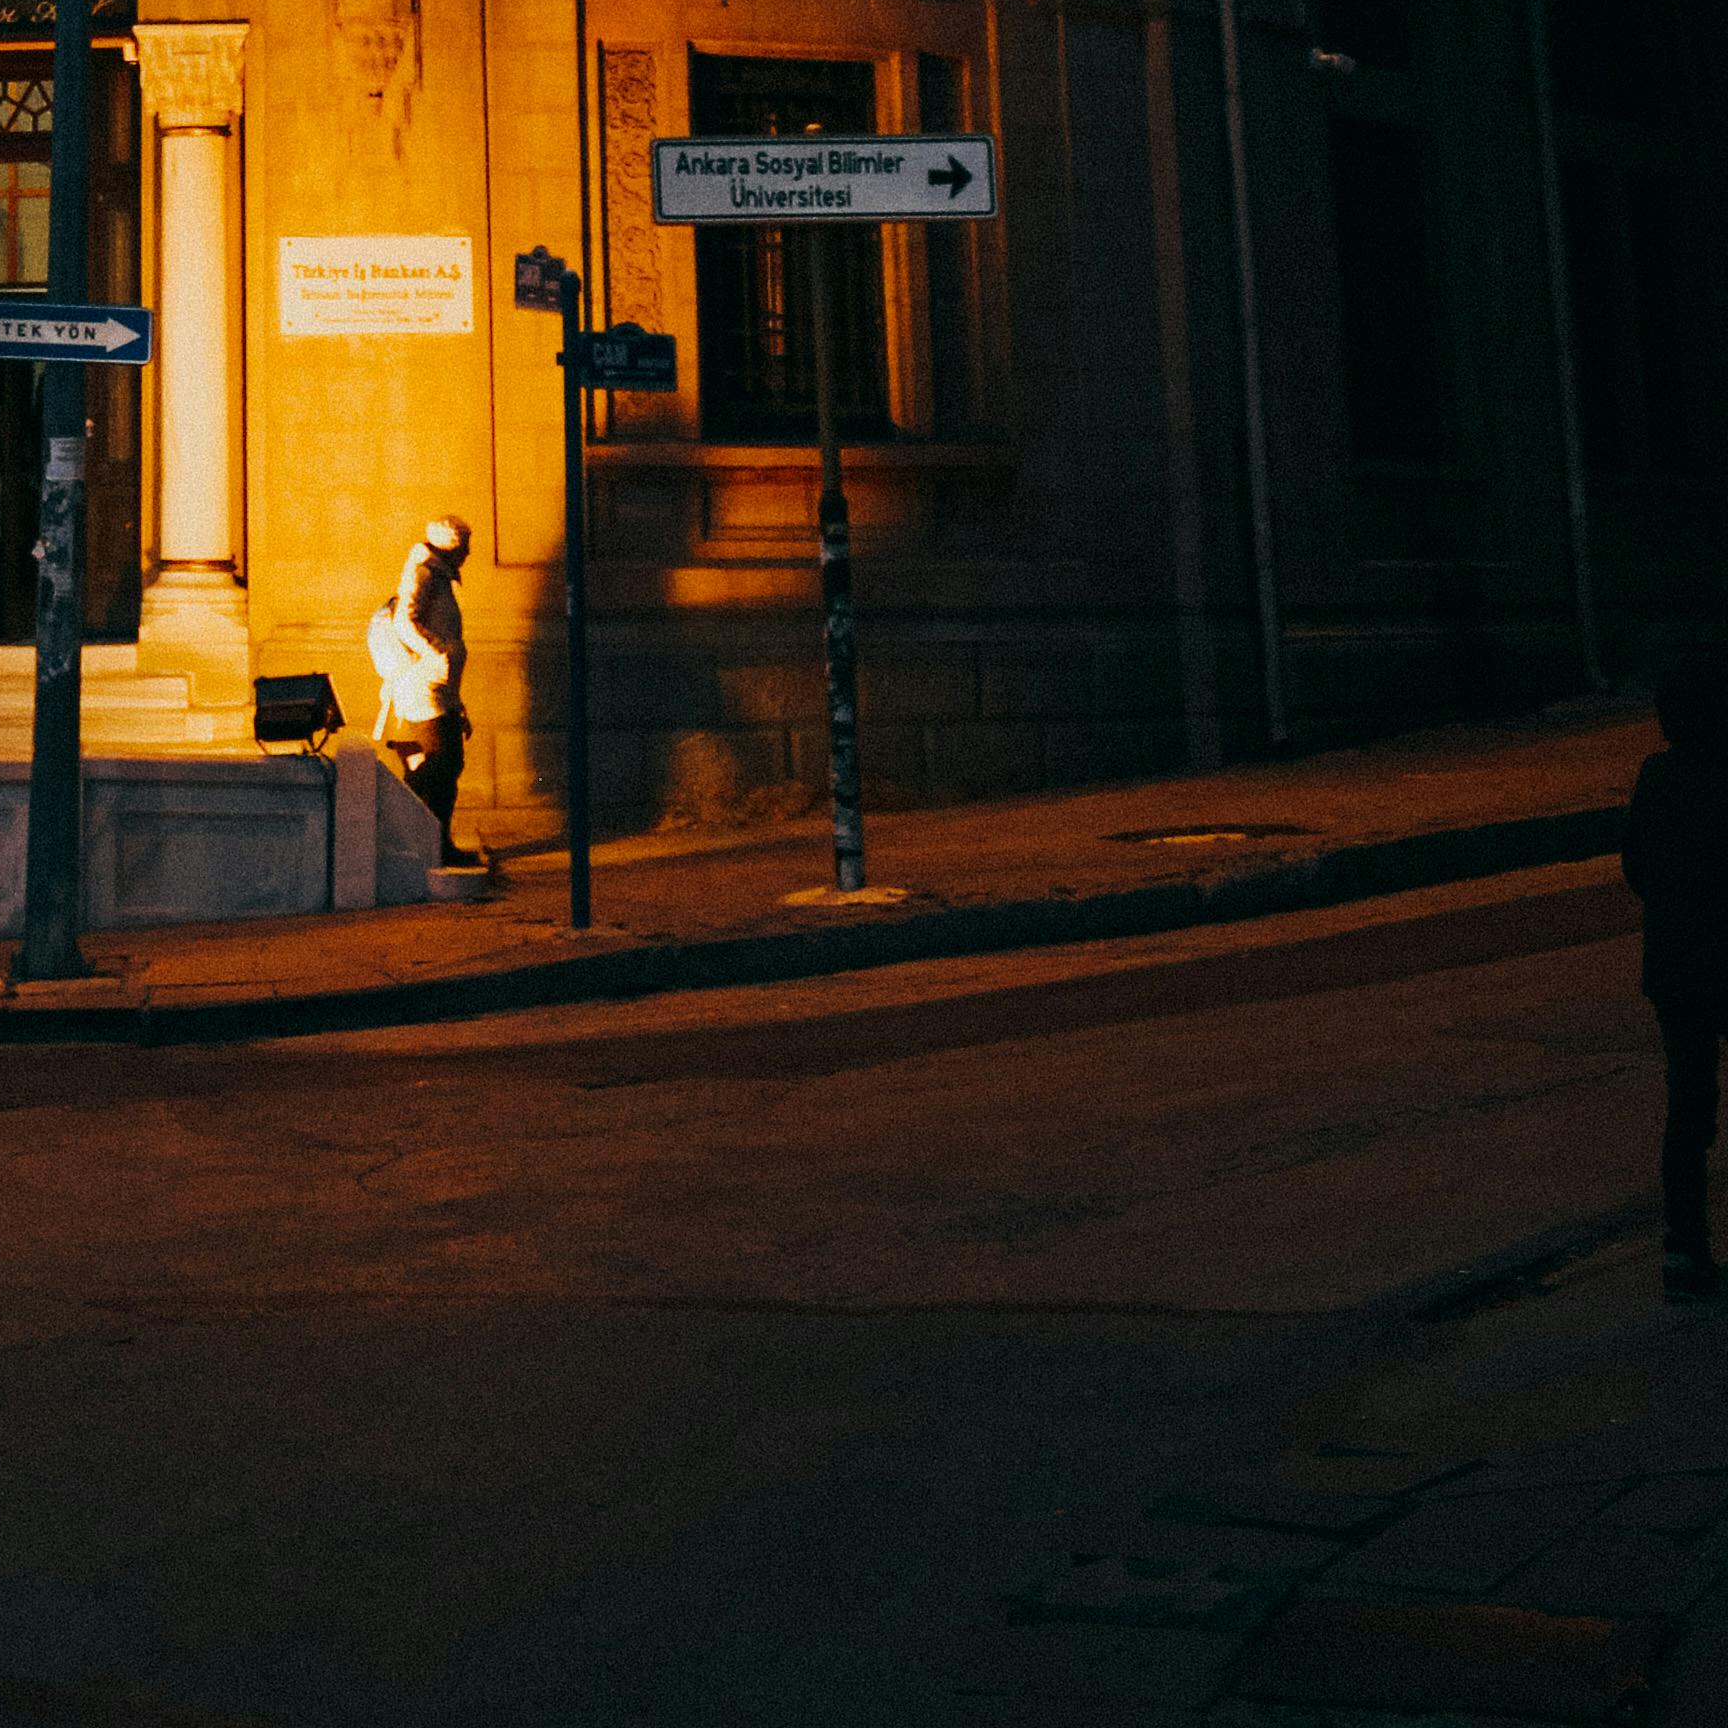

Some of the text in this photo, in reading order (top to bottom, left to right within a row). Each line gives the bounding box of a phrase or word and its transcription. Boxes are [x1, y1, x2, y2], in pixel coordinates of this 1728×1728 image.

[675, 150, 905, 181] Ankara Sosyal Bilimler
[731, 179, 852, 208] Üniversitesi
[3, 323, 42, 337] TEK
